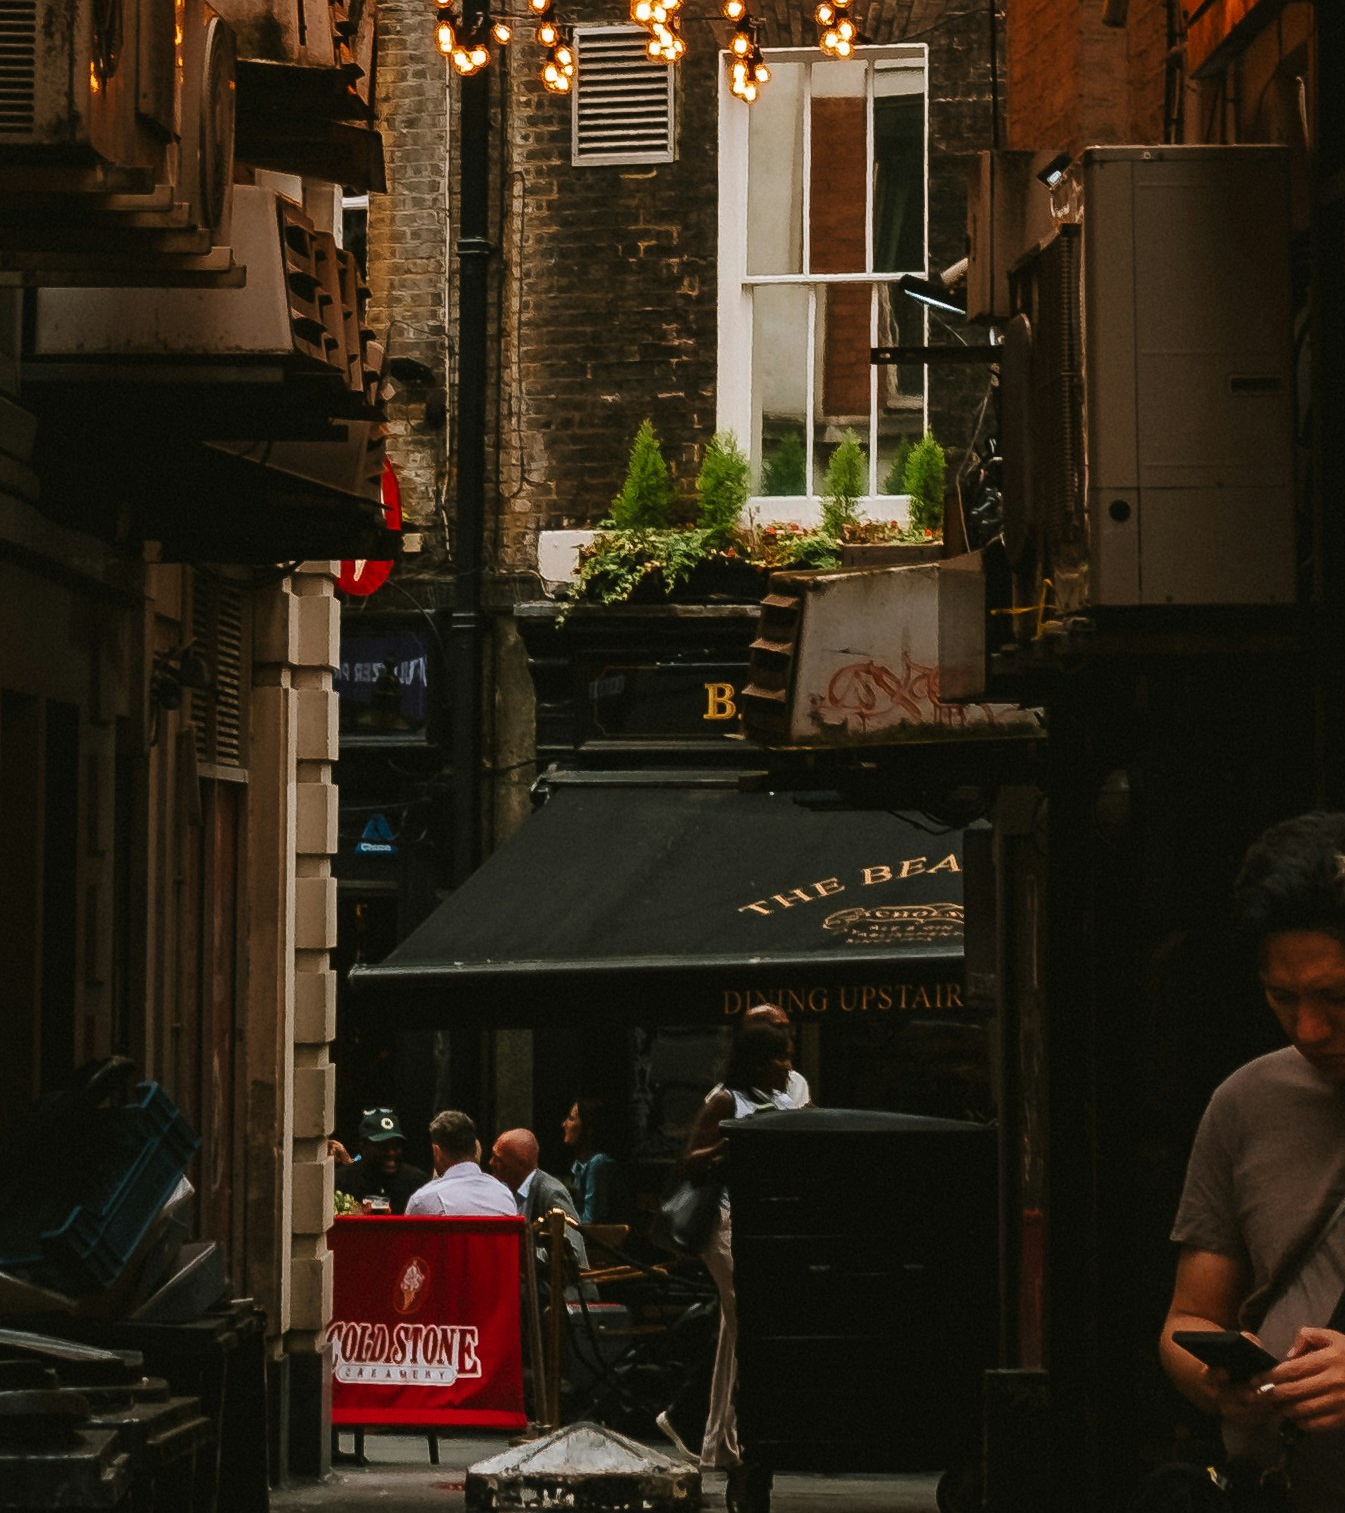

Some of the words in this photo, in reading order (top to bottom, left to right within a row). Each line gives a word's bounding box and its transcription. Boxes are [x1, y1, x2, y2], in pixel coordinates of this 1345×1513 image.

[737, 876, 846, 916] THE
[839, 981, 965, 1012] UPSTAIR
[391, 1323, 480, 1378] STONE
